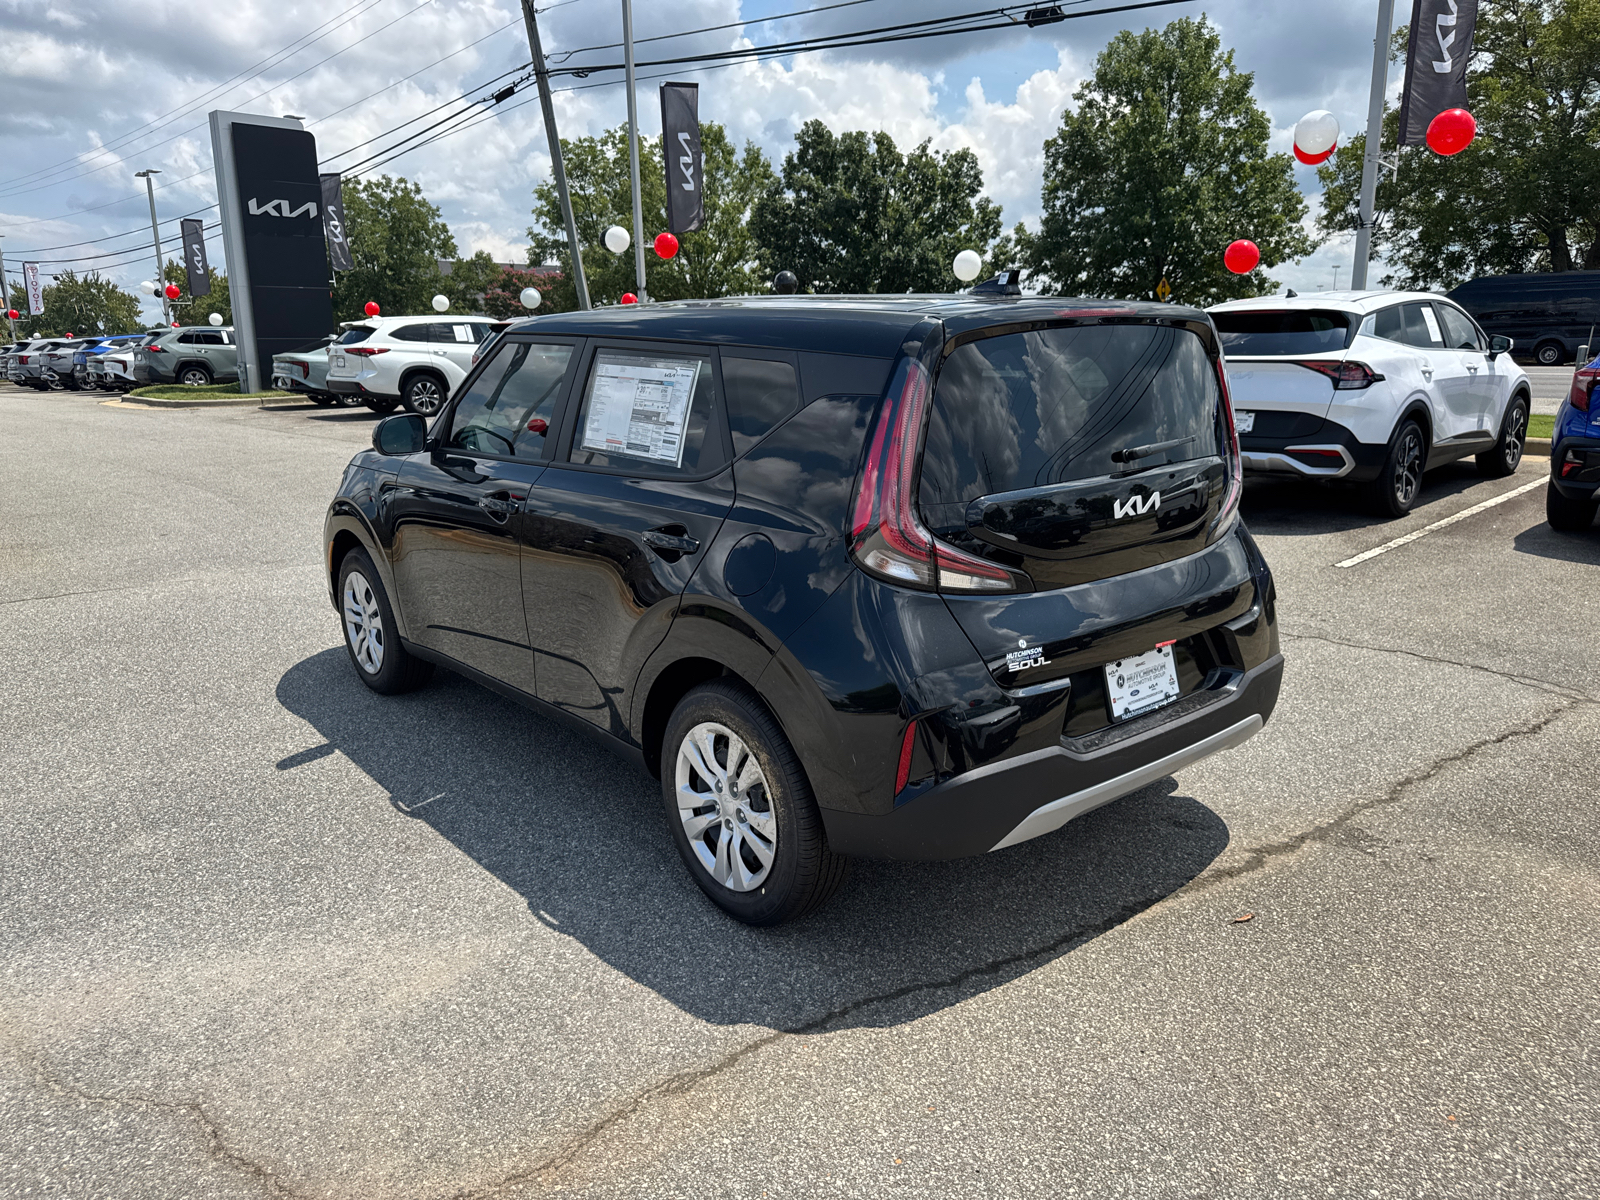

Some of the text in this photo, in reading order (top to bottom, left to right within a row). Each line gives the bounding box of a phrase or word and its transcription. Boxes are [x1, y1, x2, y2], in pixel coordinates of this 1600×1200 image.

[677, 132, 695, 191] KIA
[247, 197, 318, 219] KIA
[327, 205, 344, 243] KIA
[191, 243, 204, 275] KIA
[31, 274, 40, 312] TOYOTA
[1113, 491, 1161, 520] KIA
[1006, 646, 1043, 660] HUTCHINSON
[1008, 656, 1052, 673] SOUL
[1126, 662, 1167, 683] HUTCHINSON
[1128, 670, 1166, 689] AUTOMOTIVE GROUP
